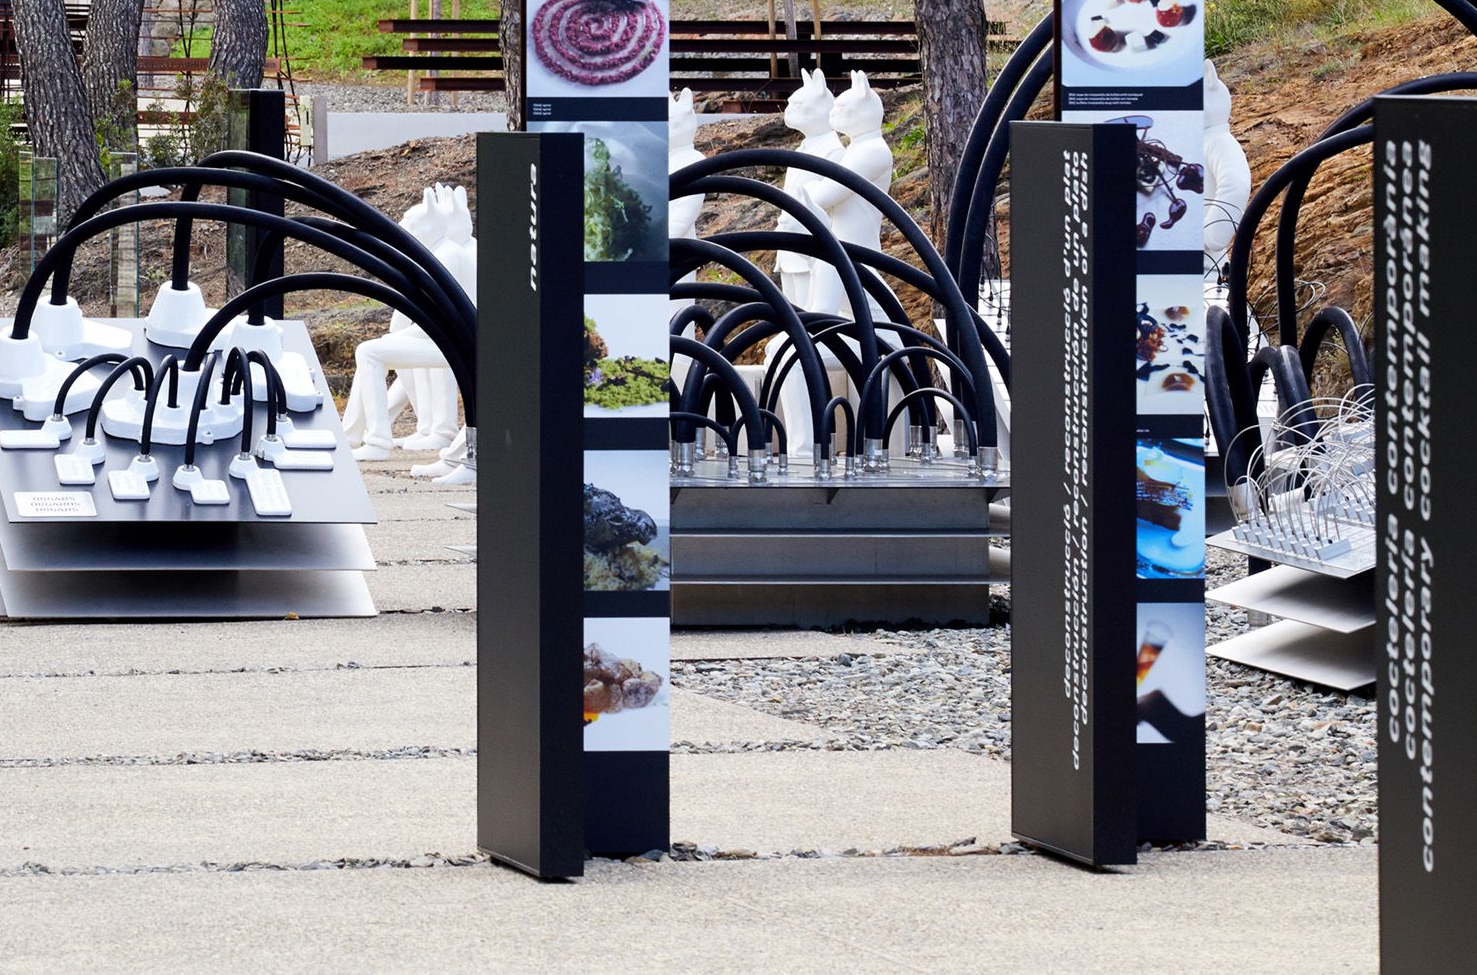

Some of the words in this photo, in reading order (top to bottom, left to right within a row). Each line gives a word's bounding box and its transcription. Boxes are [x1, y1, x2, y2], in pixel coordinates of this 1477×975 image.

[529, 163, 537, 292] natura
[1062, 150, 1072, 206] plat
[1071, 152, 1081, 224] plato
[1073, 232, 1080, 268] un
[1080, 152, 1088, 212] dish
[1080, 244, 1088, 275] of
[1081, 222, 1088, 238] a
[1416, 140, 1433, 317] making
[1063, 288, 1071, 475] reconstrucció
[1071, 278, 1080, 312] de
[1080, 285, 1088, 487] reconstruction
[1383, 140, 1400, 495] contemporània
[1399, 141, 1416, 510] contemporánea
[1071, 323, 1080, 528] reconstrucción
[1416, 331, 1432, 521] cocktail
[1063, 504, 1071, 699] deconstrucció
[1071, 558, 1080, 771] deconstrucción
[1080, 516, 1088, 725] deconstruction
[1419, 537, 1435, 873] contemporary
